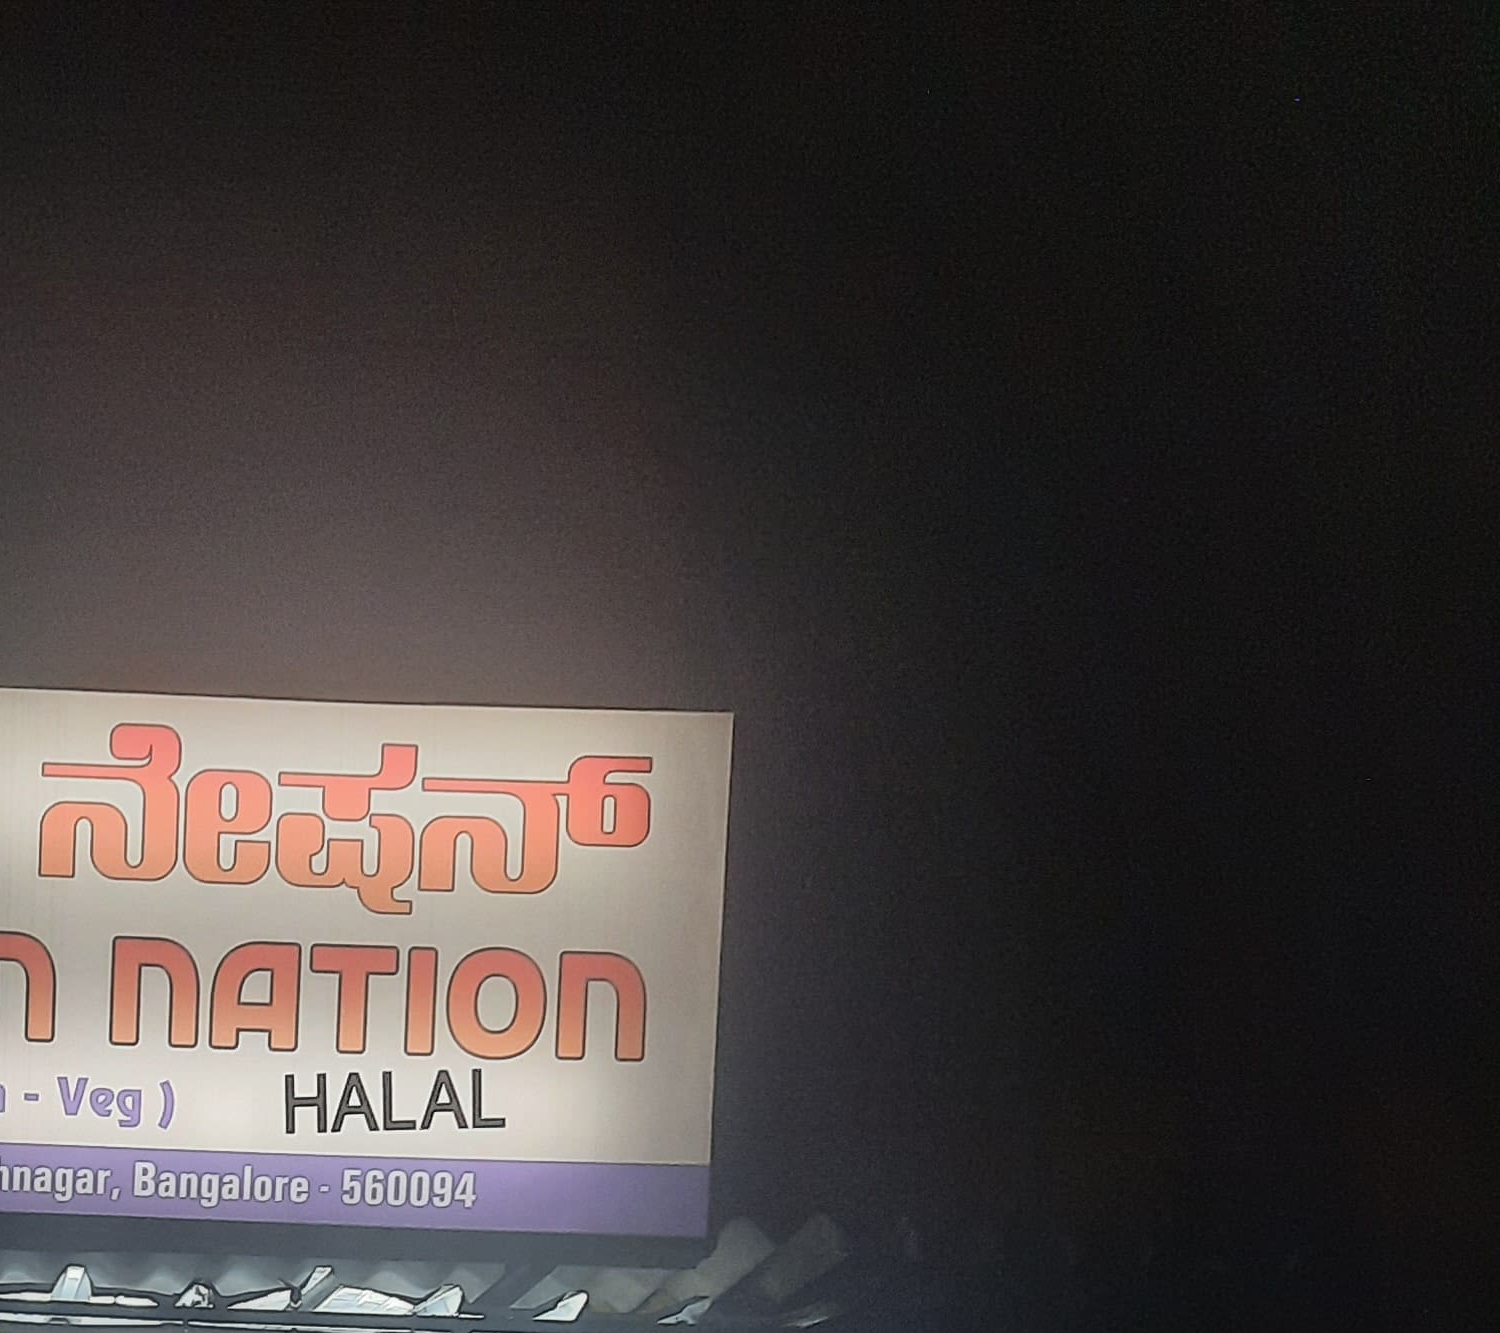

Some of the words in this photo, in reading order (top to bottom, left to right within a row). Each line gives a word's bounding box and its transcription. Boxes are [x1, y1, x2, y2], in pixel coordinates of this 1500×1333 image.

[38, 722, 653, 915] ನೇಷನ್
[108, 936, 648, 1061] NATION
[284, 1068, 507, 1135] HALAL
[132, 1164, 309, 1207] Bangalore
[340, 1168, 478, 1208] 560094
